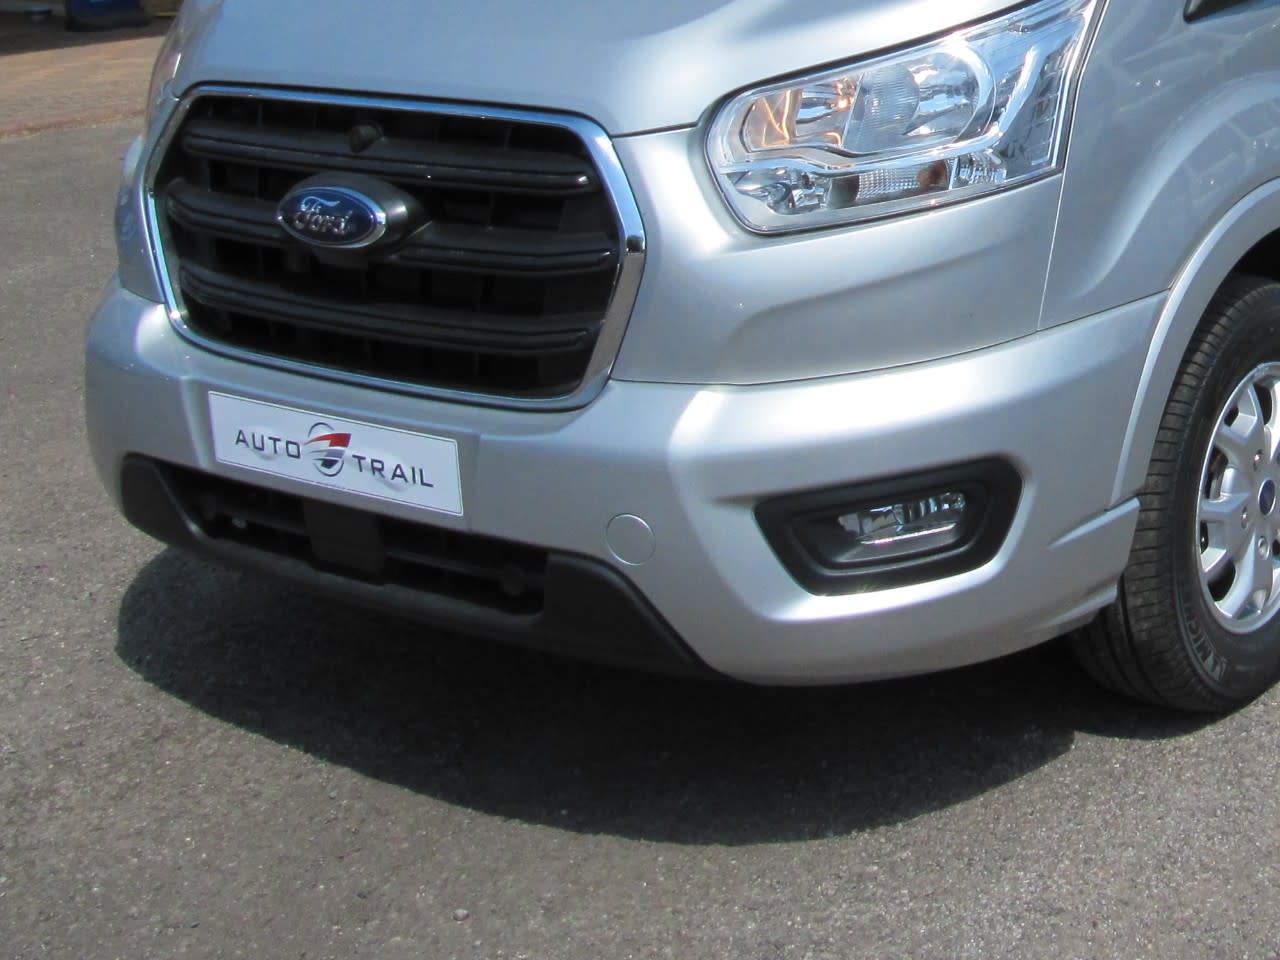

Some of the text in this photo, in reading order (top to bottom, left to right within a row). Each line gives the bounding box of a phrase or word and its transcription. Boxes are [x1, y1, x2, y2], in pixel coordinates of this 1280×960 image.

[294, 195, 354, 236] Ford
[235, 429, 434, 488] AUTO TRAIL
